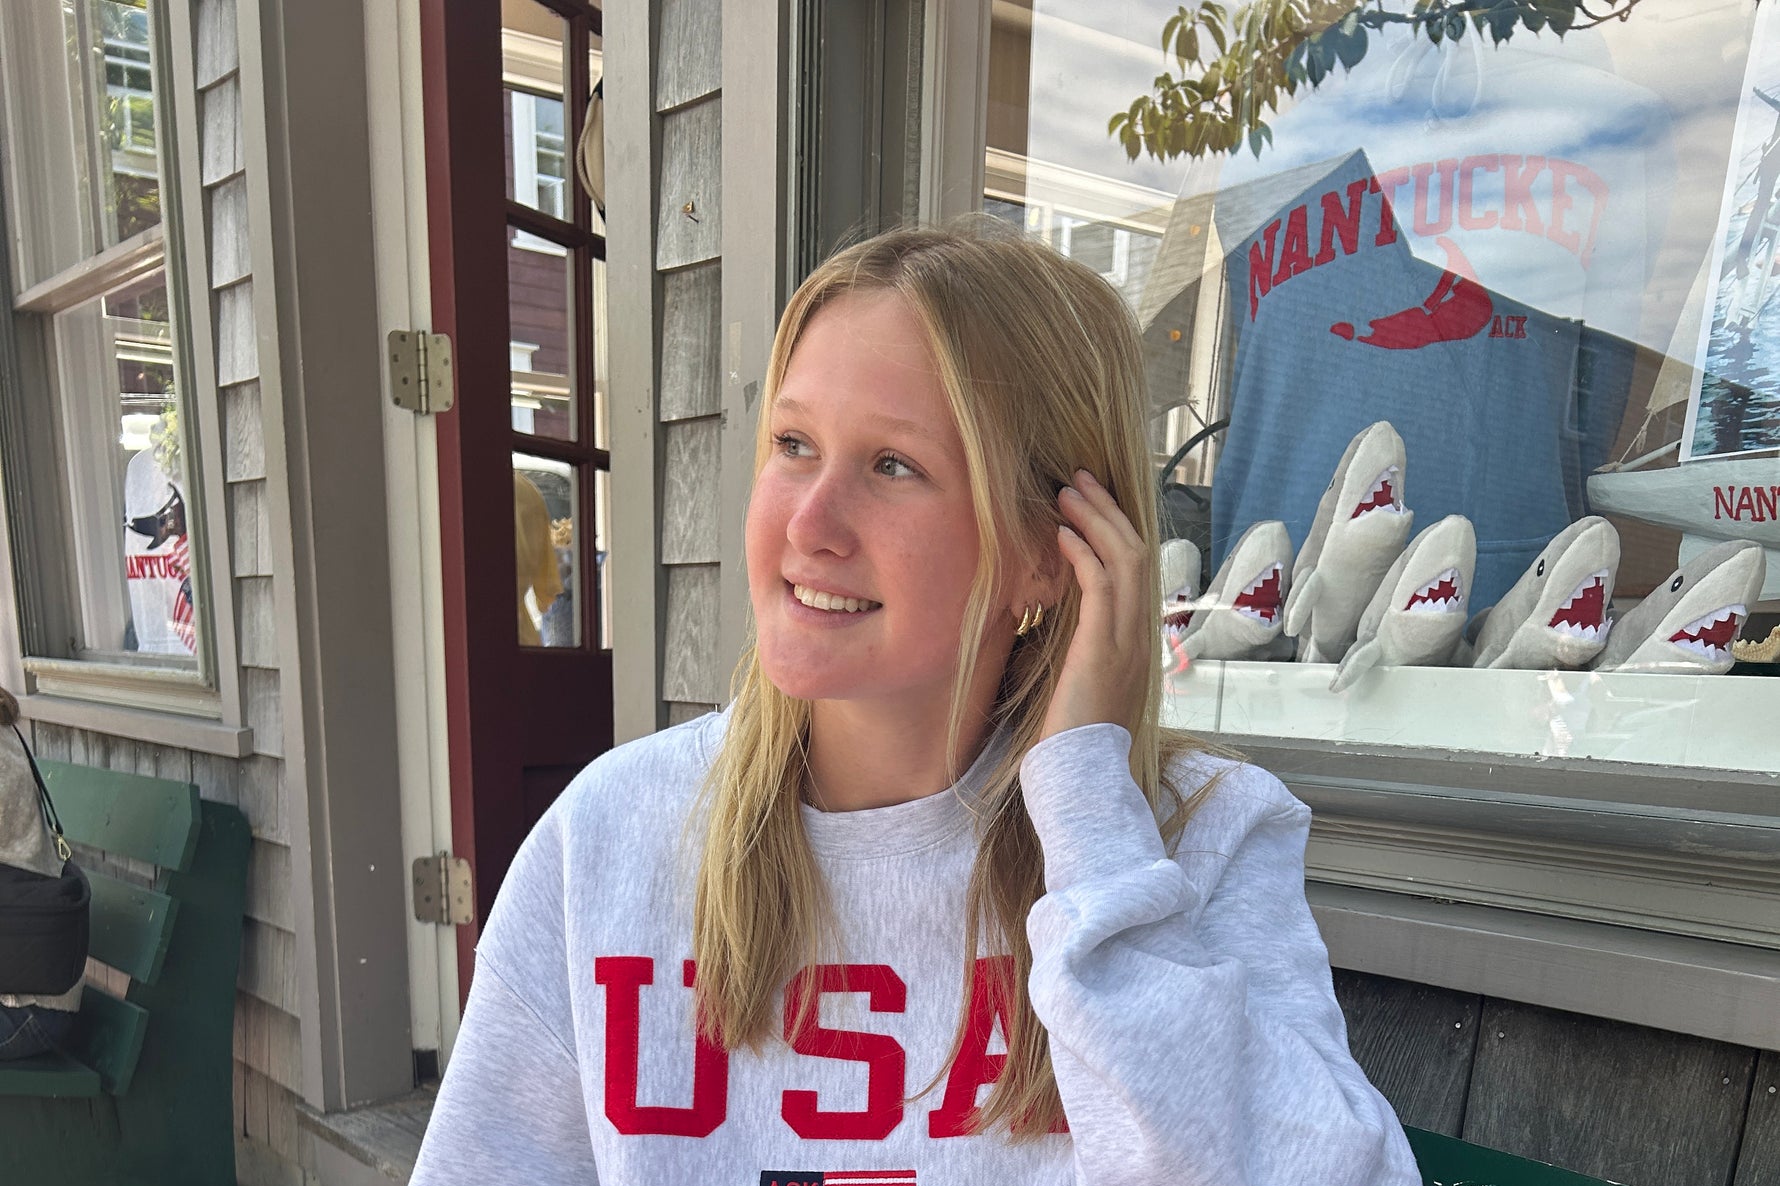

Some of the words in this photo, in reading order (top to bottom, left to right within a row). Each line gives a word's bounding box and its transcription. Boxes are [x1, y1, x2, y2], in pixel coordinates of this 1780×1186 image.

[1488, 314, 1528, 339] ACK
[1713, 485, 1780, 522] NAN
[595, 955, 1071, 1140] USA
